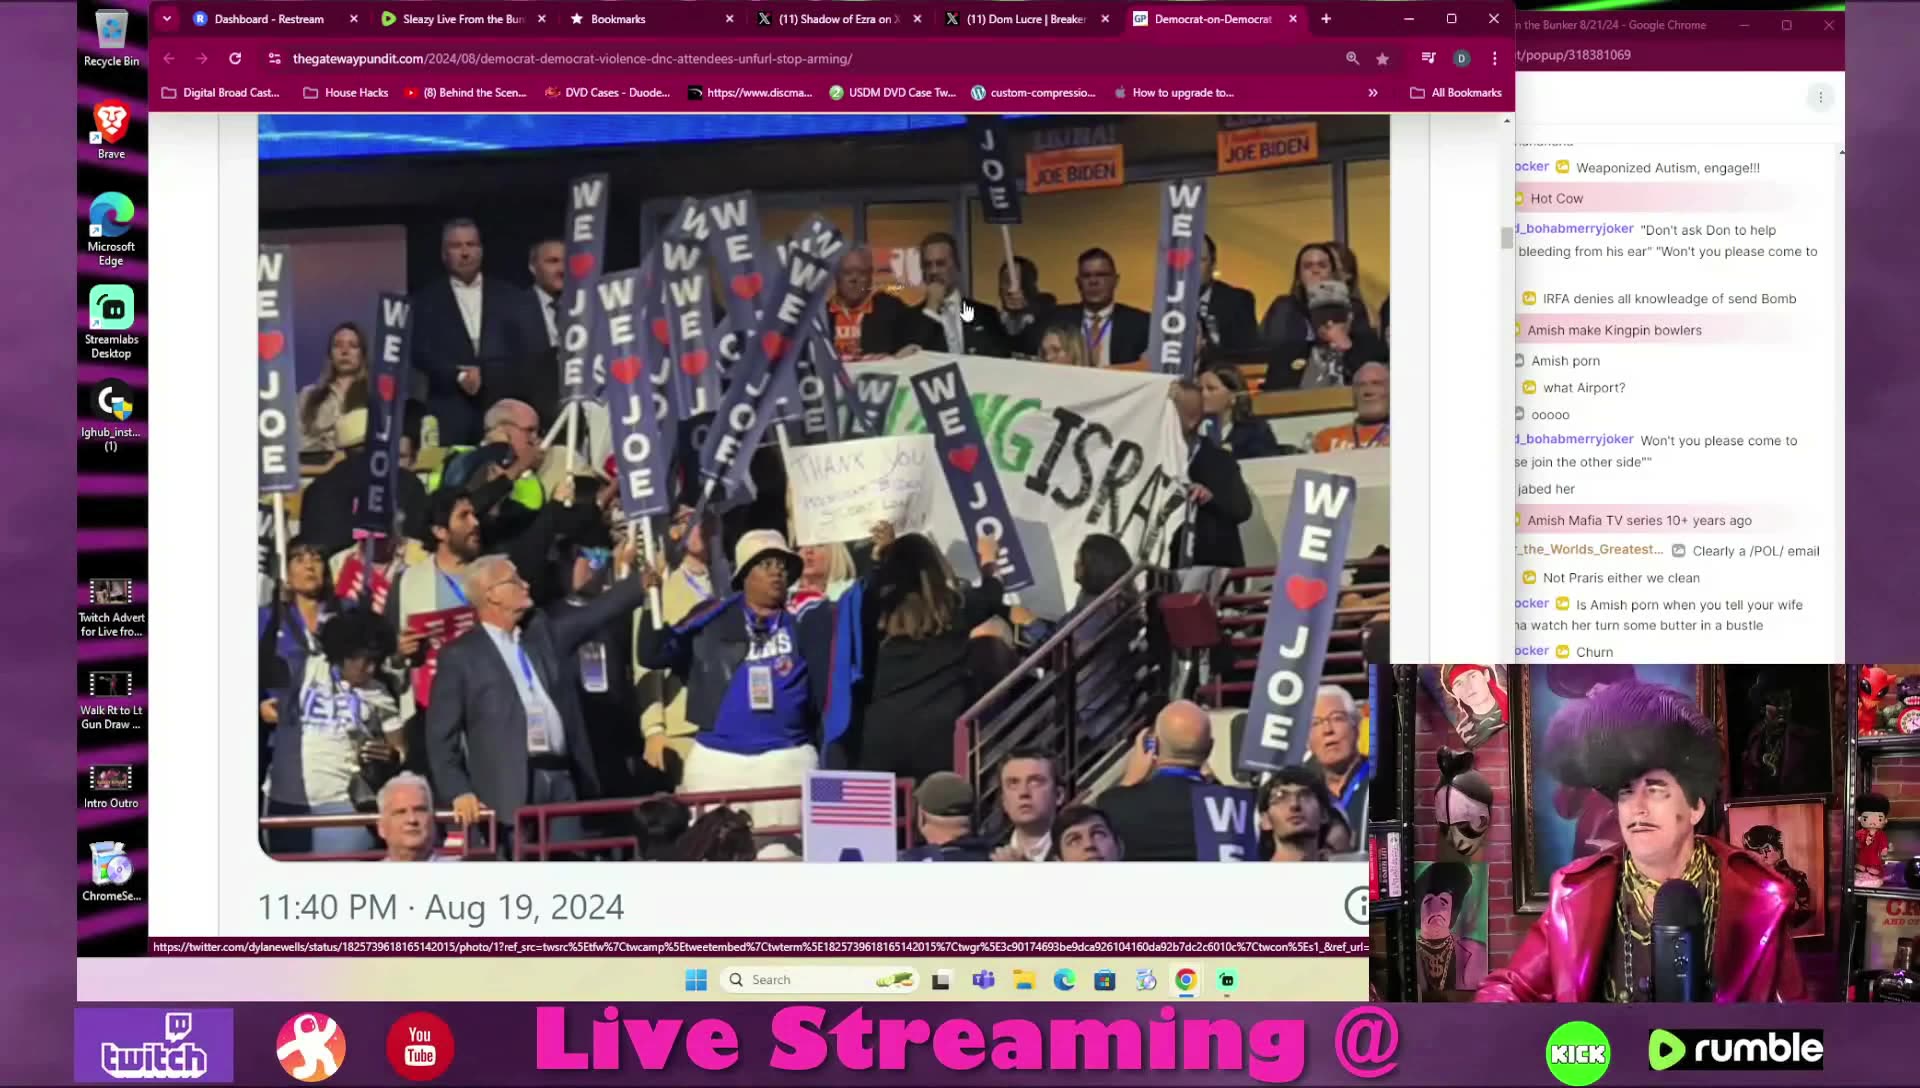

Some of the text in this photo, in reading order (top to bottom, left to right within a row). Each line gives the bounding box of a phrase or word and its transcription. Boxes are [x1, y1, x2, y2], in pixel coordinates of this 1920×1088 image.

[215, 13, 325, 24] Dashboard Restream
[403, 13, 435, 27] Sleazy
[436, 13, 457, 24] Live
[458, 13, 485, 24] From
[486, 13, 504, 24] the
[591, 13, 647, 24] Bookmarks
[779, 13, 892, 26] (11) Shadow of Ezra on
[966, 13, 987, 26] (11)
[988, 13, 1014, 24] Dom
[1015, 13, 1043, 24] Lucre
[1155, 13, 1273, 24] Democrat-on-Democrat
[1523, 19, 1708, 33] the Bunker 8/21/24 Google Chrome
[84, 55, 140, 69] Recycle Bin
[183, 87, 216, 101] Digital
[218, 87, 248, 98] Broad
[325, 87, 389, 98] House Hacks
[423, 87, 437, 100] (8)
[439, 87, 474, 98] Behind
[475, 87, 493, 98] the
[565, 87, 589, 98] DVD
[590, 87, 620, 98] Cases
[849, 87, 881, 98] USDM
[883, 87, 907, 98] DVD
[908, 87, 933, 98] Case
[1133, 87, 1156, 98] How
[1157, 88, 1169, 98] to
[1171, 87, 1214, 101] upgrade
[1431, 87, 1503, 98] All Bookmarks
[98, 148, 126, 159] Brave
[1224, 136, 1310, 163] JOE BIDEN
[981, 128, 1009, 209] JOE
[1034, 163, 1116, 186] JOE BIDEN
[1576, 162, 1760, 177] Weaponized Autism, engage!!!
[1530, 192, 1584, 205] Hot Cow
[87, 241, 136, 252] Microsoft
[99, 255, 124, 268] Edge
[1160, 184, 1201, 365] WE JOE
[564, 180, 603, 386] WE JOE
[1573, 293, 1615, 305] denies
[1617, 293, 1631, 305] all
[1711, 292, 1725, 305] of
[1728, 293, 1758, 305] send
[1761, 293, 1797, 305] Bomb
[383, 298, 410, 363] WE
[1527, 324, 1703, 339] Amish make Kingpin bowlers
[85, 333, 139, 345] Streamlabs
[91, 347, 132, 361] Desktop
[257, 252, 287, 474] WE JOE
[598, 277, 654, 500] WE JOE
[1543, 382, 1626, 396] what Airport?
[919, 373, 966, 437] WE
[104, 440, 118, 453] (1)
[1527, 514, 1565, 527] Amish
[1568, 514, 1603, 526] Mafia
[1605, 514, 1623, 526] TV
[1626, 515, 1663, 526] series
[1692, 516, 1726, 529] years
[1729, 517, 1753, 529] ago
[1693, 545, 1820, 560] Clearly a /POL/ email
[1543, 572, 1565, 584] Not
[1607, 572, 1643, 584] either
[1646, 574, 1665, 584] we
[1667, 572, 1700, 584] clean
[78, 612, 145, 623] Twitch Advert
[1260, 480, 1349, 752] WE JOE
[80, 626, 97, 637] for
[98, 626, 118, 637] Live
[80, 705, 143, 715] Walk Rt to Lt
[81, 718, 130, 729] Gun Draw
[84, 797, 139, 808] Intro Outro
[259, 893, 625, 929] 11:40 PM Aug 19, 2024
[752, 974, 791, 985] Search
